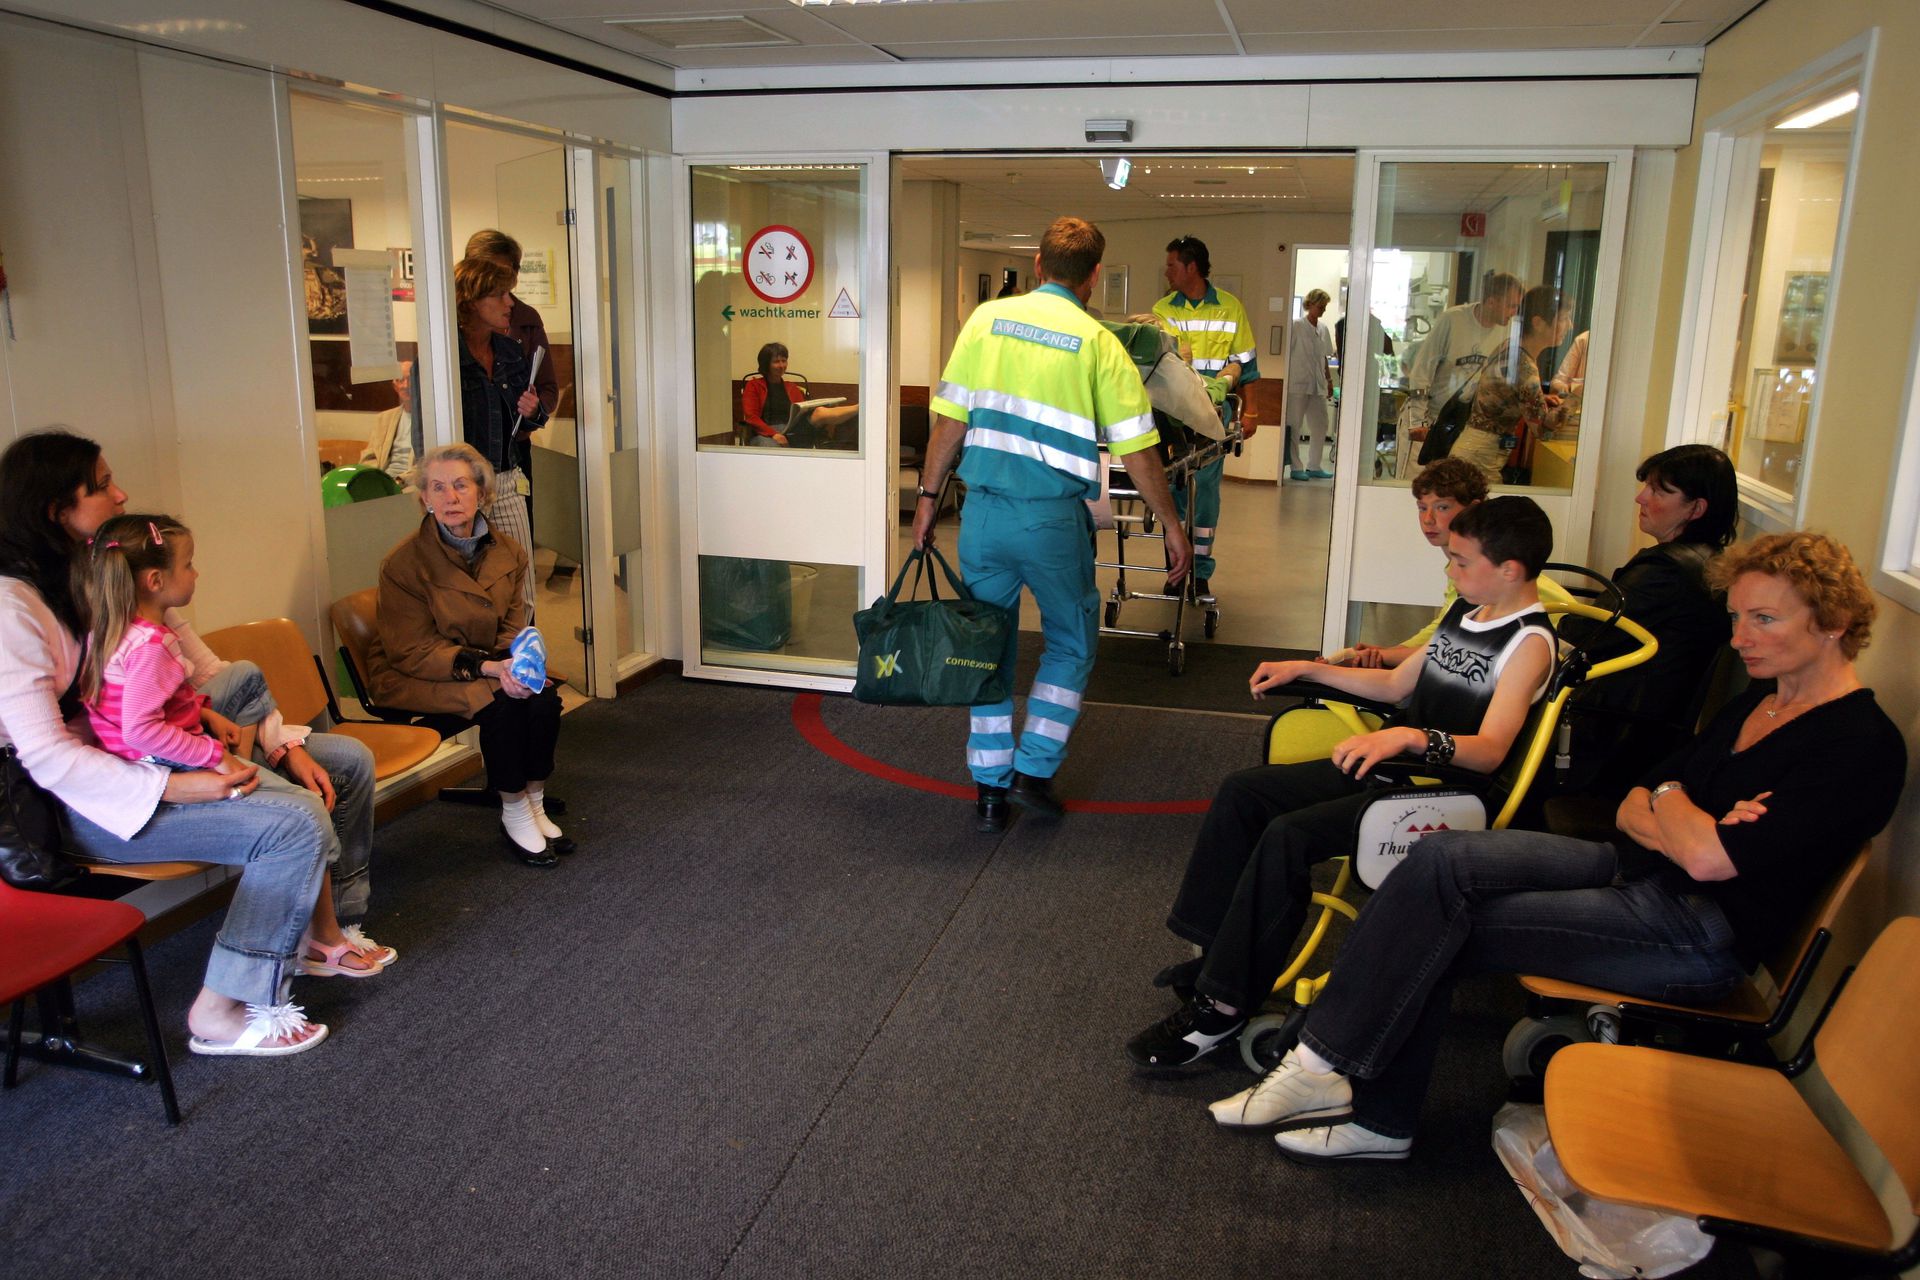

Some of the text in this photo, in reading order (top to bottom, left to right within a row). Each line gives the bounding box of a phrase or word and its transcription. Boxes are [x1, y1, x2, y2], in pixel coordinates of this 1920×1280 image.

[740, 305, 821, 319] wachtkamer
[993, 320, 1080, 351] AMBULANCE
[945, 656, 998, 670] connexxion
